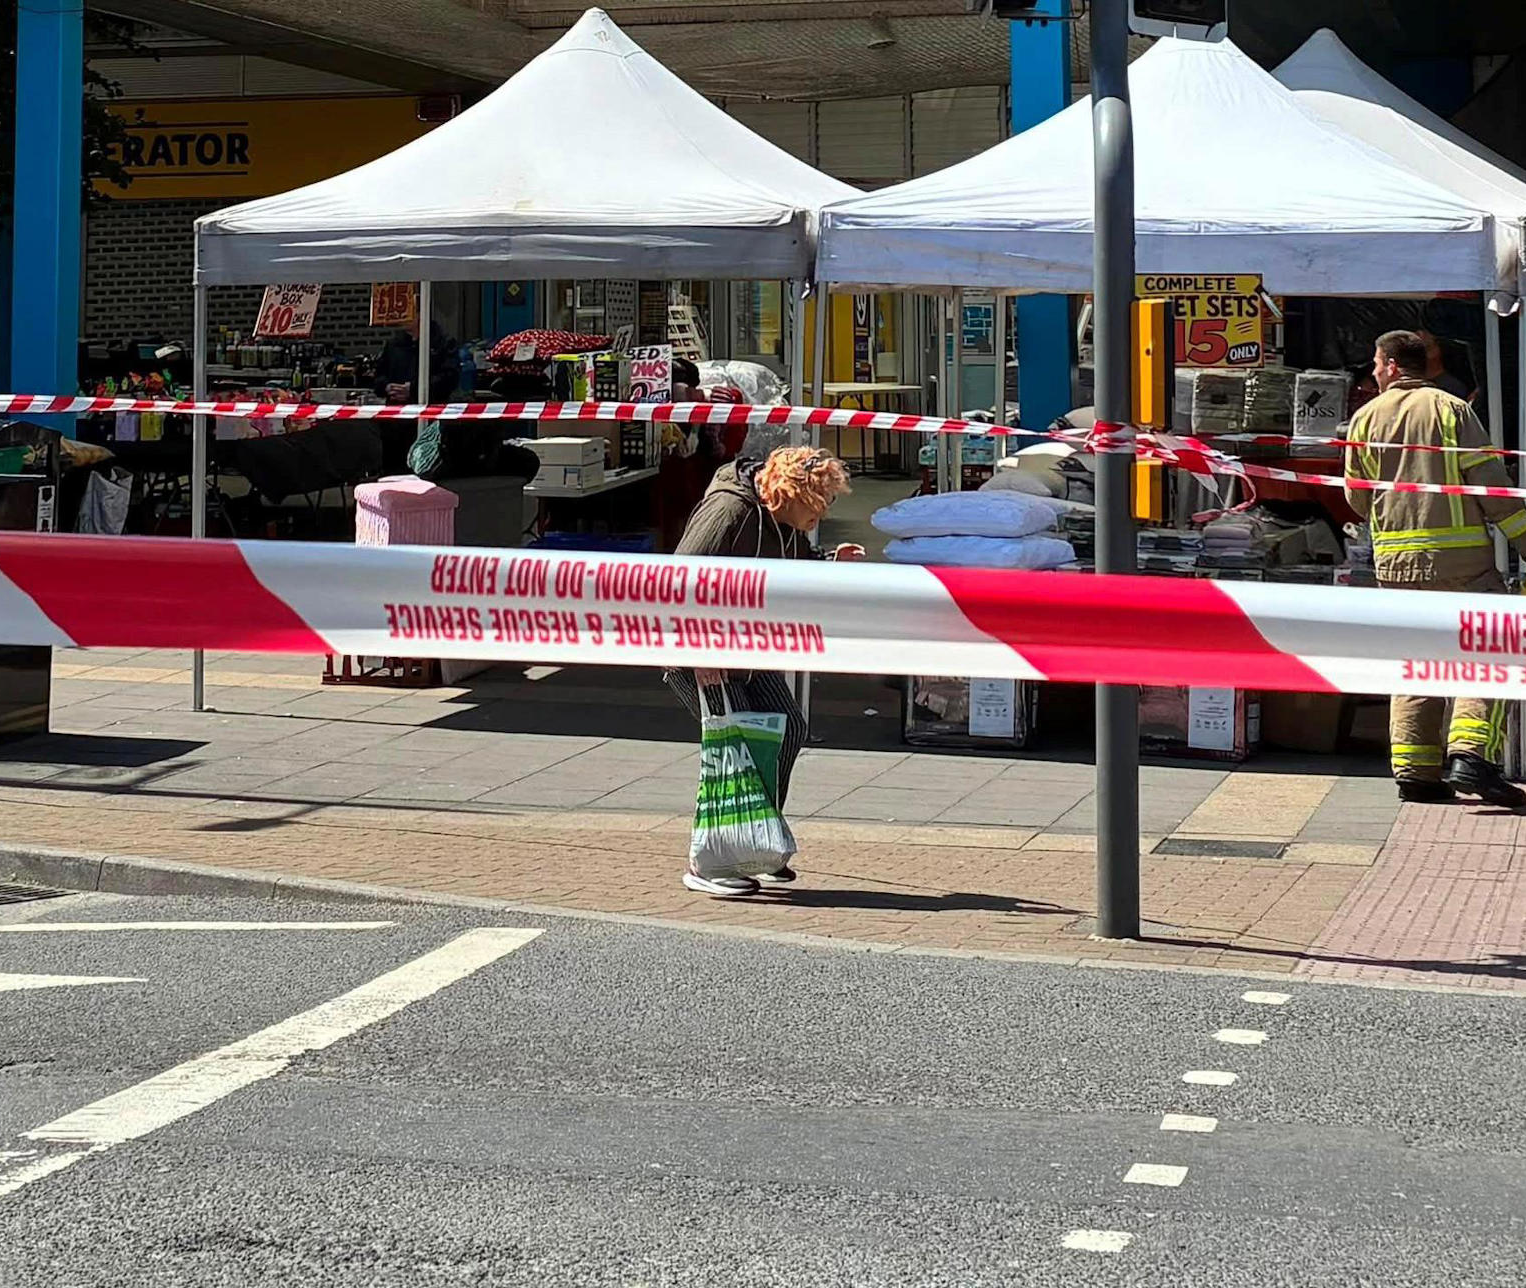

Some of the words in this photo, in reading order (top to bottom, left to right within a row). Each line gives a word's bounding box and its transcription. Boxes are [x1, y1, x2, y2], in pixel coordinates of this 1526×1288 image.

[280, 293, 303, 306] BOX
[1144, 277, 1236, 291] COMPLETE
[260, 305, 294, 335] £10
[1207, 295, 1258, 317] SETS
[1175, 319, 1229, 366] 15
[1229, 345, 1258, 361] ONLY
[430, 553, 499, 595] ENTER
[504, 557, 549, 597] NOT
[695, 566, 768, 609] INNER
[384, 603, 484, 641] SERVICE
[489, 608, 580, 645] RESCUE
[610, 613, 665, 649] FIRE
[670, 615, 825, 654] MERSEYSIDE
